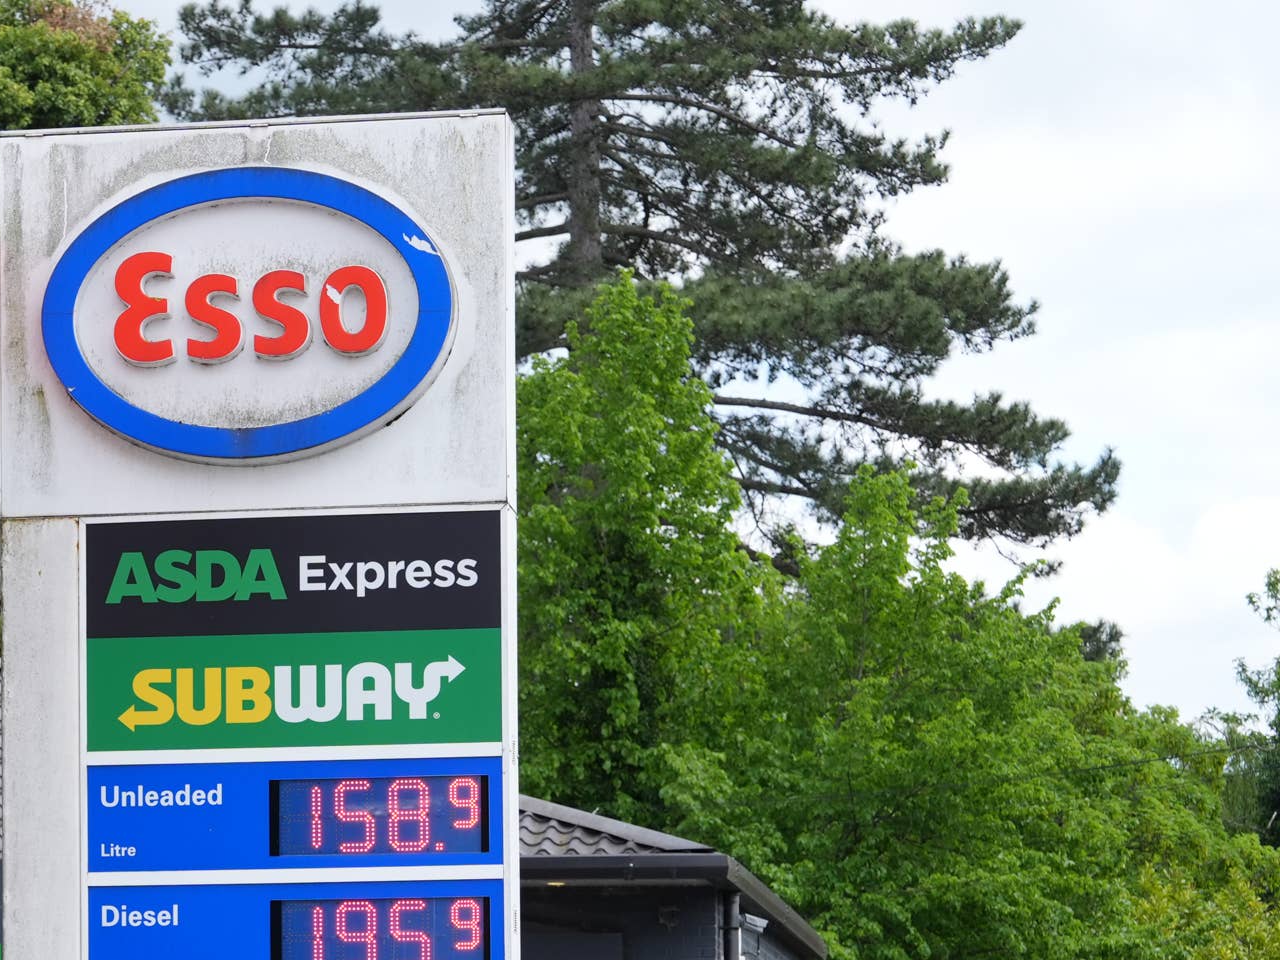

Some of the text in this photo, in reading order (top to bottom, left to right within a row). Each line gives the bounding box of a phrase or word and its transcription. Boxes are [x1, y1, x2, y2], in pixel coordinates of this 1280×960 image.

[114, 251, 392, 367] Esso
[105, 548, 479, 604] ASDA Express
[117, 654, 466, 732] SUBWAY
[100, 777, 479, 853] Unleaded 158.9
[100, 844, 137, 857] Litre
[101, 904, 179, 927] Diesel
